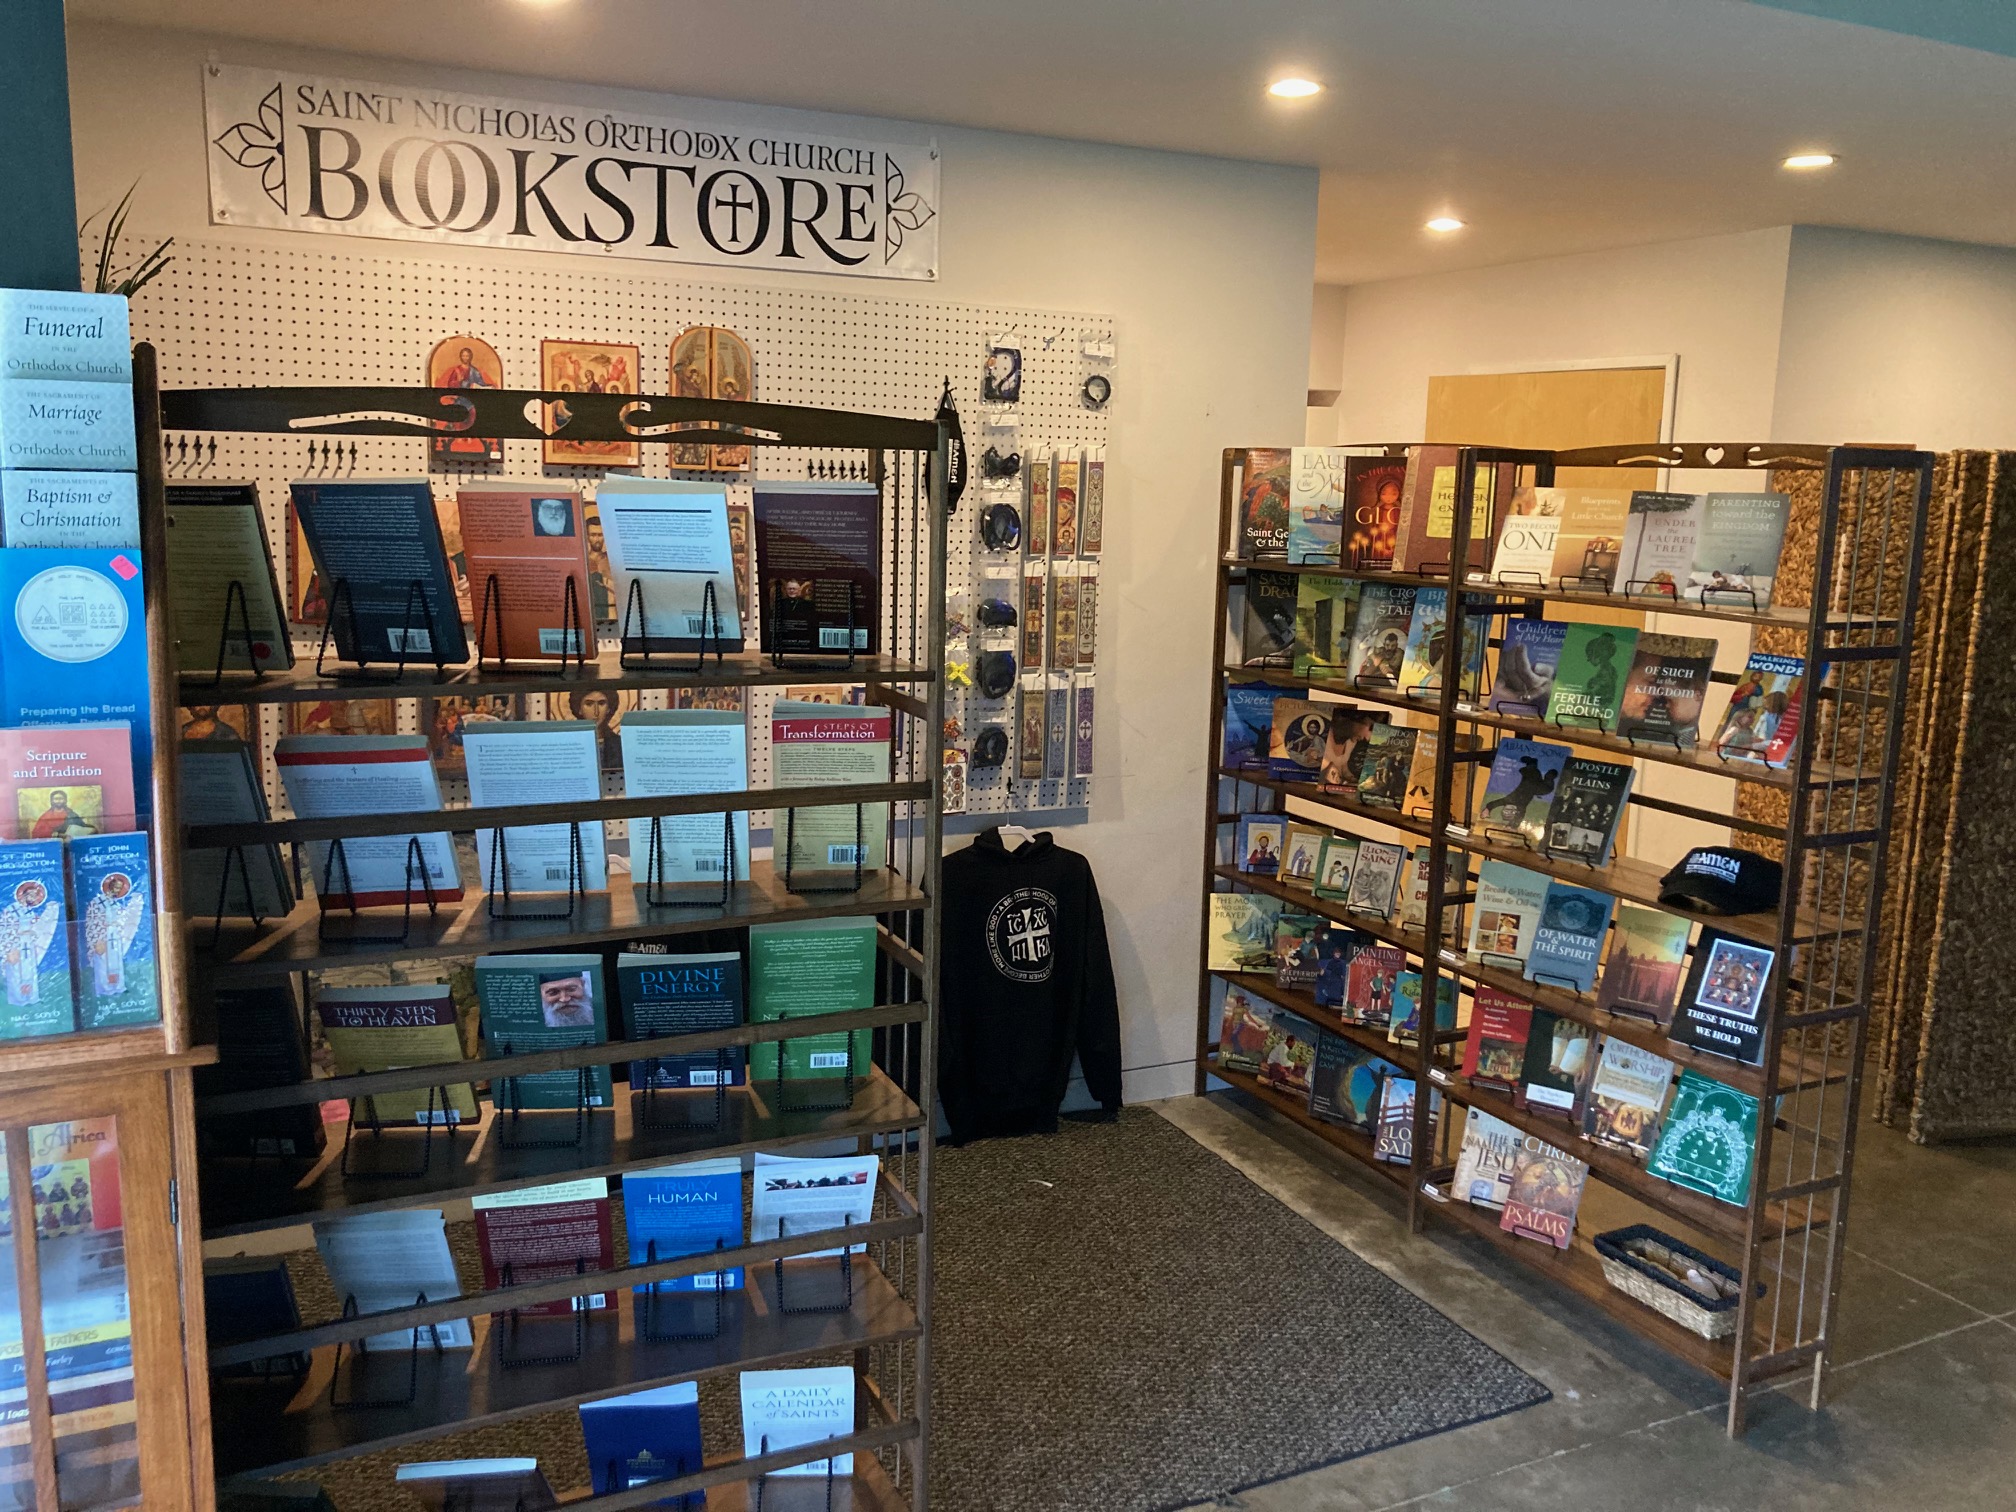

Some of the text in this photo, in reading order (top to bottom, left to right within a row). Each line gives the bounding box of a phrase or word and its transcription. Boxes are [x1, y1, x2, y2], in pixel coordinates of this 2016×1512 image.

[296, 84, 876, 176] SAINT NICHOLAS ORTHODOX CHURCH
[302, 125, 876, 267] BOOKSTORE
[24, 316, 104, 340] Funeral
[8, 359, 123, 375] Orthodox Church
[28, 404, 103, 426] Marriage
[9, 443, 127, 458] Orthodox Church
[951, 449, 960, 483] AMEN
[27, 488, 113, 507] Baptism &
[1581, 496, 1621, 506] Blueprints
[1711, 499, 1781, 508] PARENTING
[20, 511, 121, 528] Chrismation
[1571, 512, 1624, 521] Little Church
[1711, 508, 1776, 520] toward the
[1655, 519, 1697, 528] UNDER
[1711, 522, 1770, 531] KINGDOM
[1247, 527, 1273, 538] Saint
[1256, 537, 1285, 547] & the
[1648, 535, 1697, 545] LAUREL
[1654, 545, 1688, 553] TREE
[1389, 587, 1416, 600] CRO
[1516, 622, 1567, 635] Children
[1515, 633, 1540, 643] of My
[1752, 654, 1797, 665] WALKING
[1645, 665, 1694, 679] OF SUCH
[1749, 660, 1805, 676] WONDE
[1233, 691, 1271, 704] Sweet
[1634, 685, 1695, 698] KINGDOM
[1553, 692, 1601, 706] FERTILE
[21, 704, 135, 719] Preparing the Bread
[1555, 704, 1614, 719] GROUND
[779, 724, 875, 739] Transformation
[859, 722, 875, 730] OF
[27, 750, 87, 763] Scripture
[13, 765, 102, 778] and Tradition
[1571, 762, 1621, 776] APOSTLE
[1571, 777, 1611, 790] PLAINS
[108, 845, 130, 853] JOHN
[1699, 852, 1740, 873] AMEN
[1483, 884, 1506, 894] Bread
[1482, 894, 1504, 903] Wine
[1506, 896, 1514, 904] &
[1215, 911, 1247, 919] PRAYER
[1538, 928, 1597, 948] OF WATER
[1550, 936, 1559, 945] &
[638, 943, 667, 954] AMEN
[1353, 946, 1401, 961] PAINTING
[1535, 941, 1594, 961] THE SPIRIT
[1353, 957, 1383, 967] ANGELS
[640, 968, 725, 983] DIVINE
[642, 981, 722, 995] ENERGY
[1479, 997, 1533, 1011] Let Us Attend
[334, 1005, 436, 1017] THIRTY STEPS
[339, 1014, 436, 1027] TO HEAVEN
[1687, 1008, 1759, 1035] THESE TRUTHS
[1695, 1025, 1742, 1045] WE HOLD
[39, 1123, 107, 1156] Africa
[1476, 1147, 1516, 1172] JESU
[653, 1180, 712, 1192] TRULY
[648, 1191, 718, 1204] HUMAN
[1505, 1205, 1568, 1237] PSALMS
[50, 1330, 98, 1346] FATHERS
[766, 1387, 832, 1399] A DAILY
[752, 1398, 846, 1409] CALENDAR
[781, 1409, 840, 1419] SAINTS
